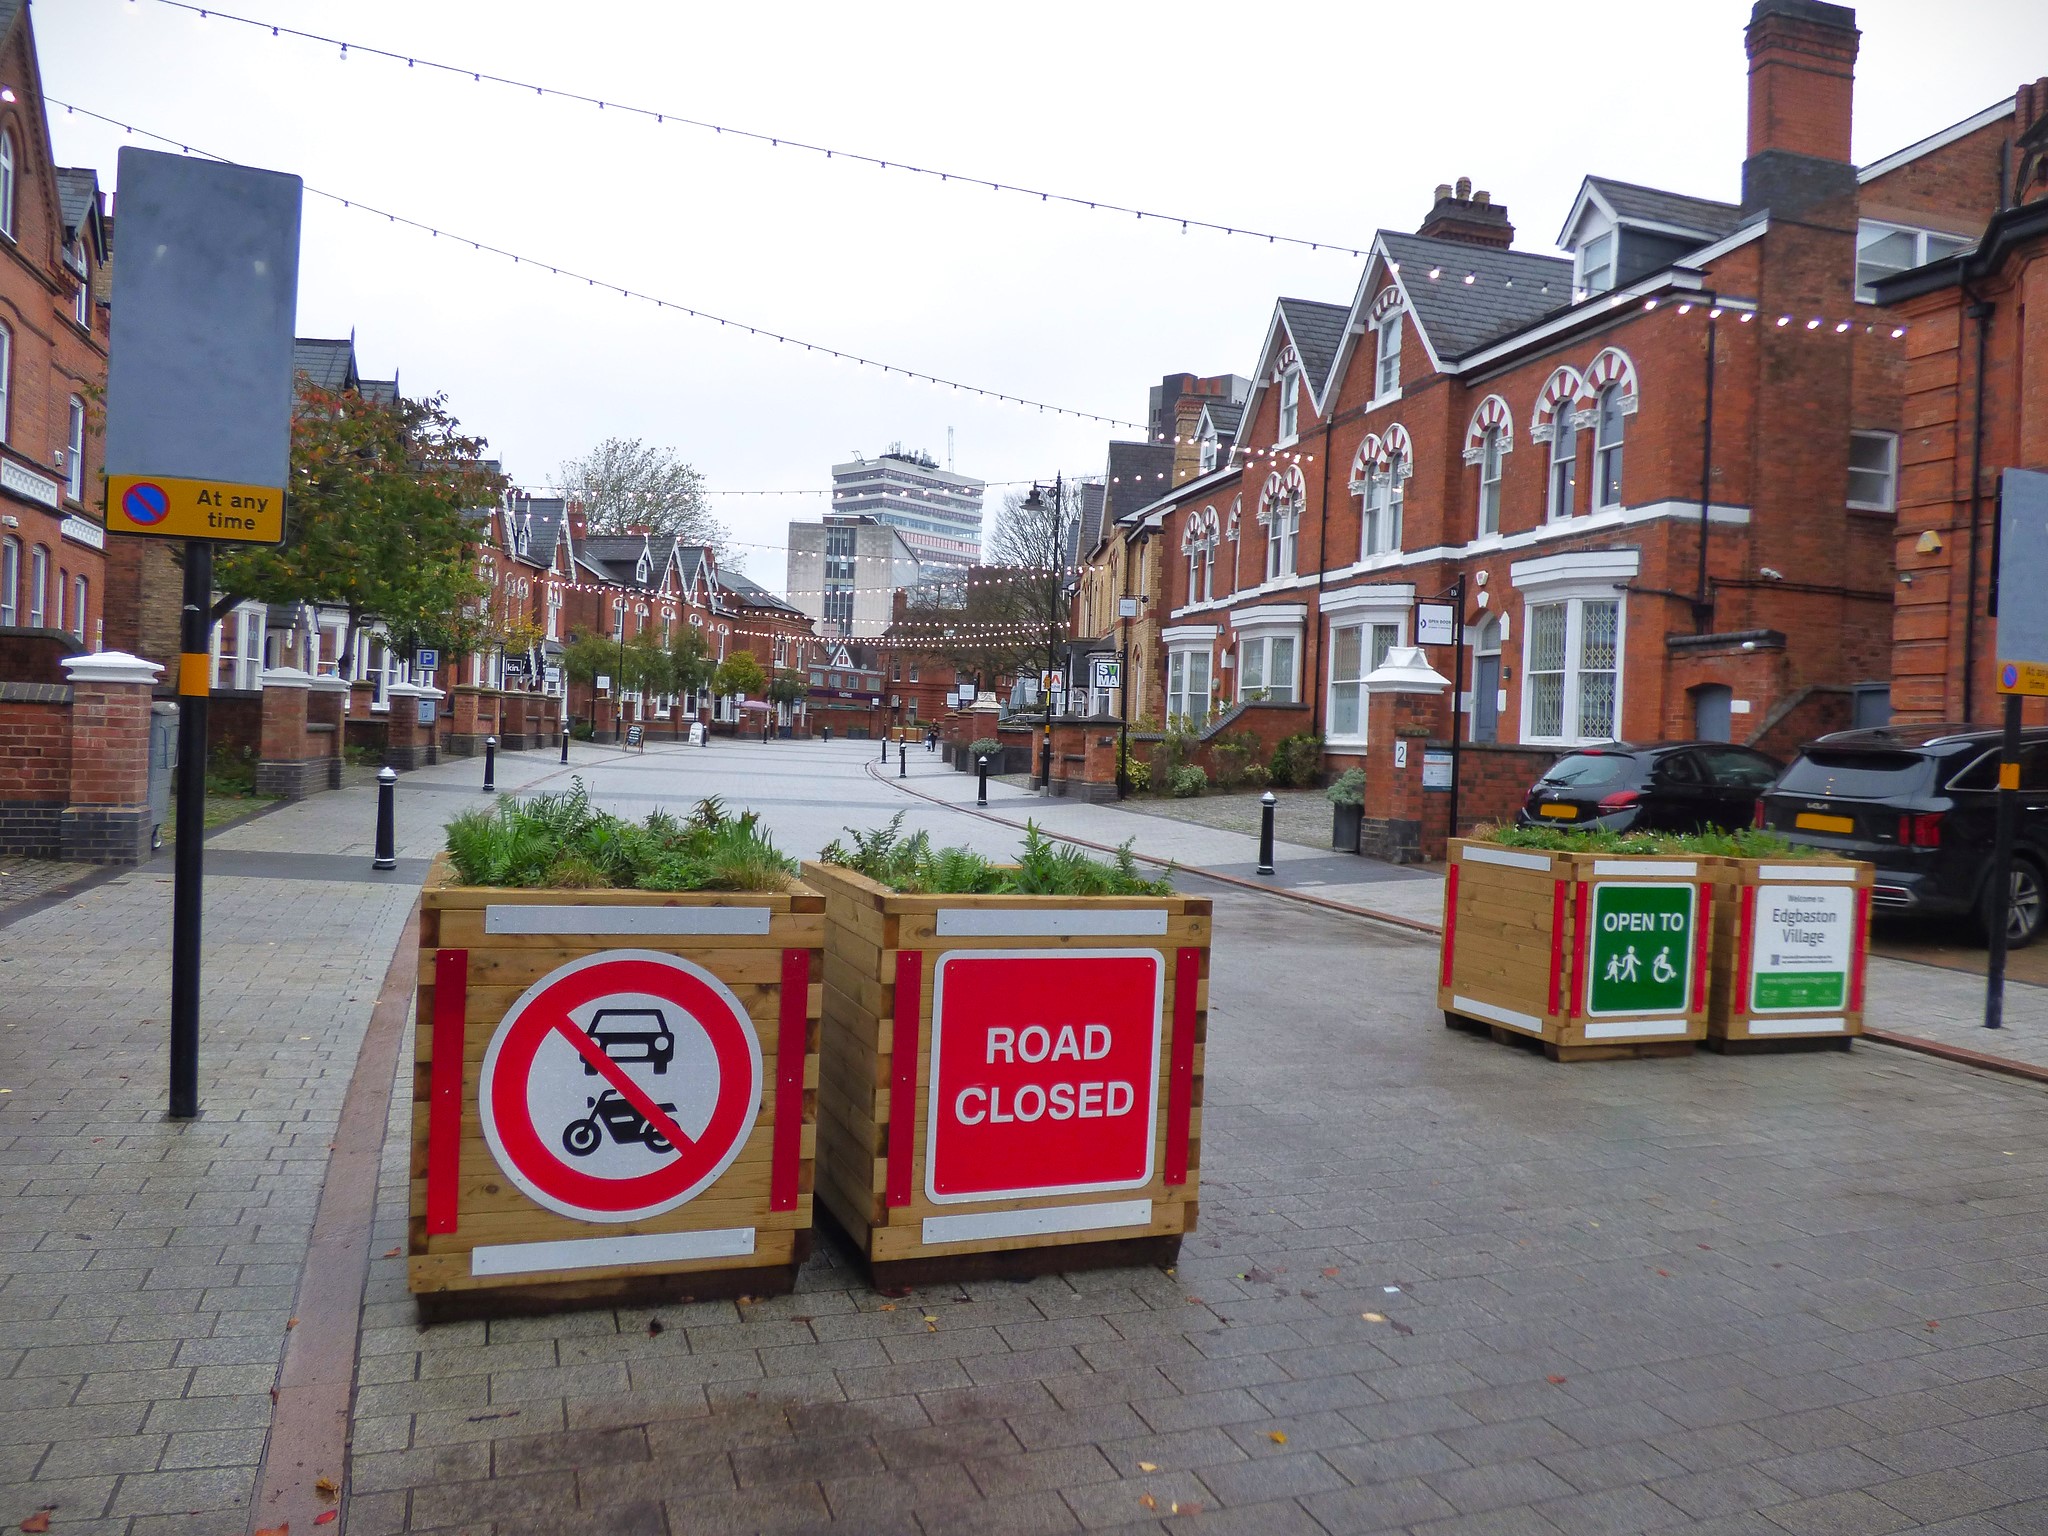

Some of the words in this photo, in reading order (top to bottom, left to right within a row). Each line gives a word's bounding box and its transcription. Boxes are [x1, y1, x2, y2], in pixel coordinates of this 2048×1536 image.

[197, 489, 222, 507] At
[230, 496, 269, 513] any
[208, 512, 256, 530] time
[423, 652, 433, 664] P
[1397, 746, 1405, 763] 2
[1787, 895, 1817, 903] Welcome
[1603, 912, 1656, 932] OPEN
[1659, 912, 1684, 932] TO
[1772, 908, 1837, 927] Edgbaston
[1782, 928, 1825, 947] Village
[986, 1024, 1112, 1064] ROAD
[955, 1081, 1134, 1126] CLOSED
